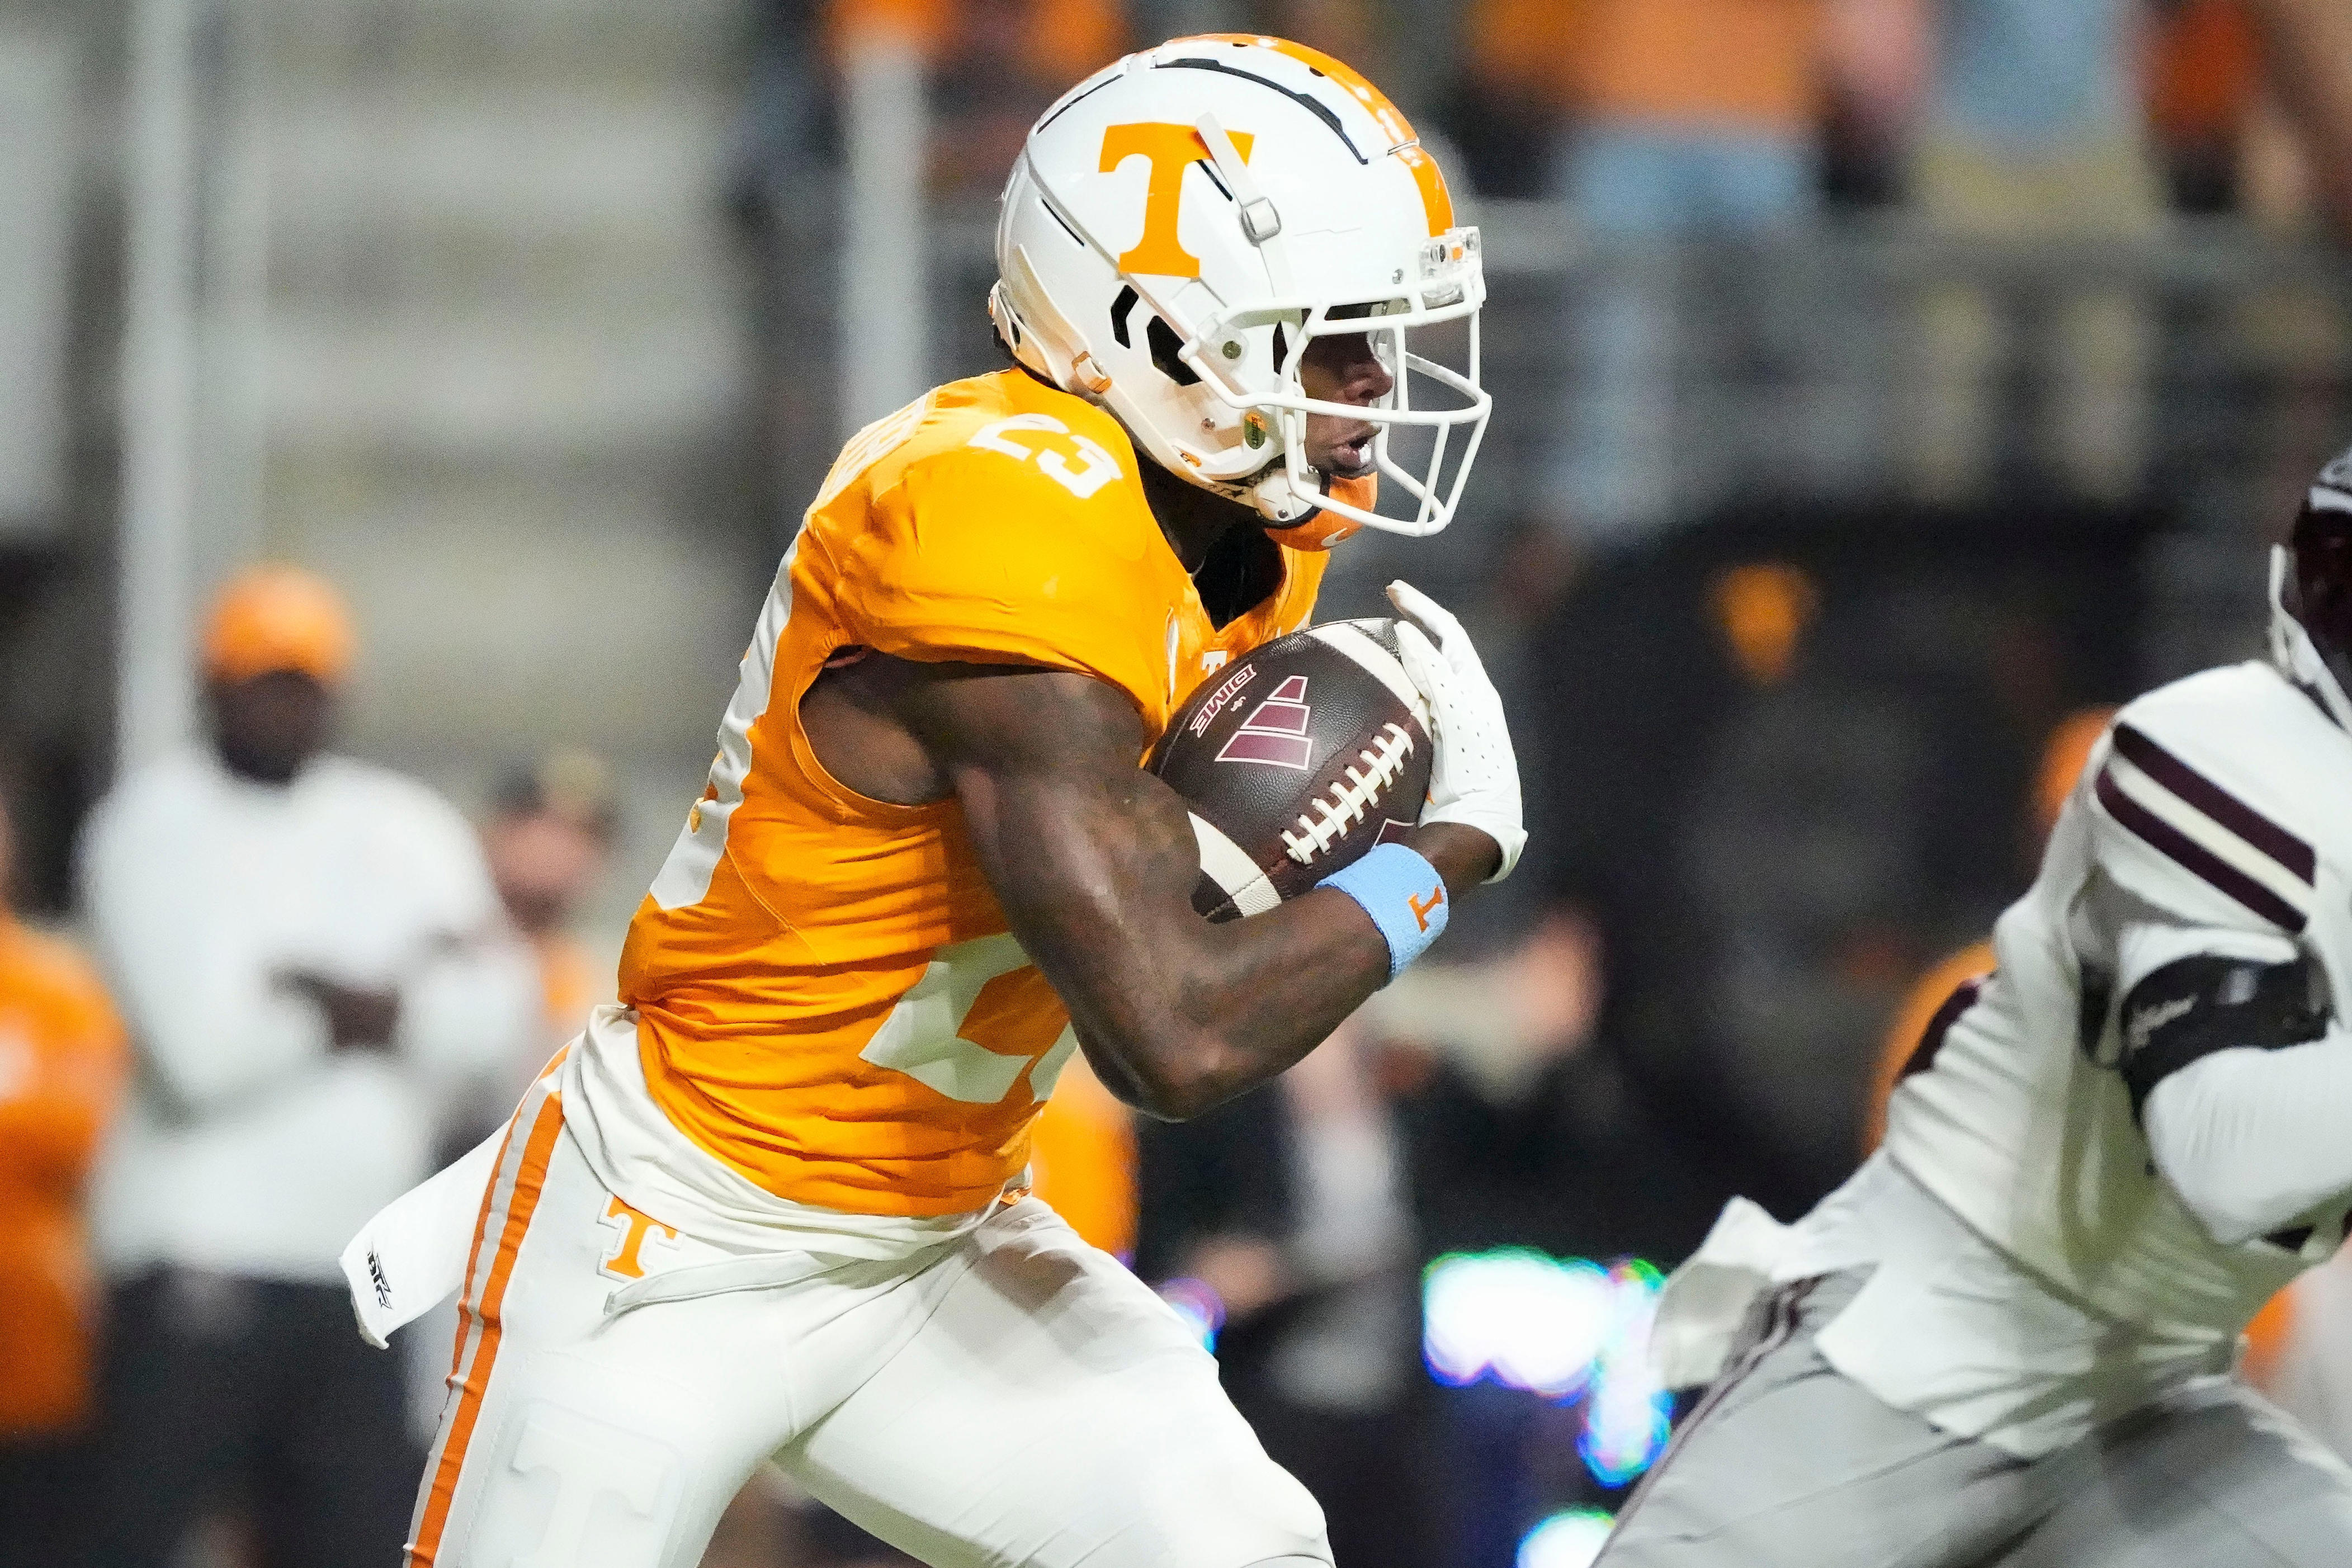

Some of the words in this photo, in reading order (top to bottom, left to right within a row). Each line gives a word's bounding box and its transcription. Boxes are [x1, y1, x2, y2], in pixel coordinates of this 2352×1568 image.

[1098, 121, 1254, 278] T
[967, 413, 1123, 499] 23
[1189, 663, 1257, 738] DIME
[1408, 885, 1443, 933] T
[604, 1194, 679, 1279] T
